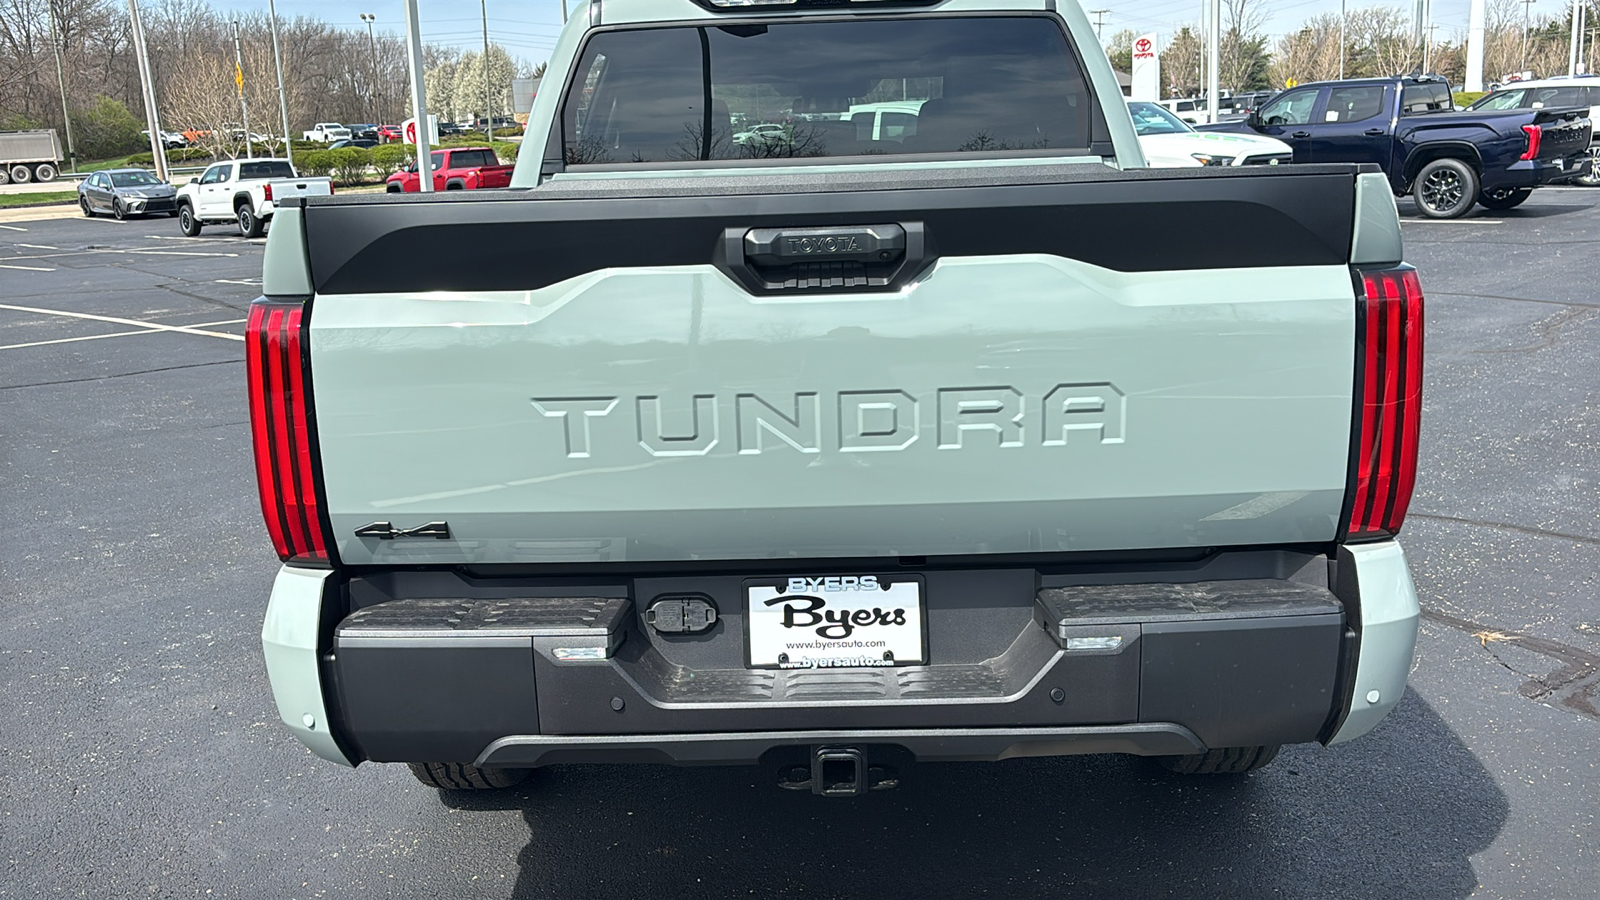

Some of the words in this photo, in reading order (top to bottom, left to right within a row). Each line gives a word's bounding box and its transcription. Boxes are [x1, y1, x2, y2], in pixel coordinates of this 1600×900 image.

[789, 237, 862, 254] TOYOTA
[531, 382, 1127, 459] TUNDRA
[788, 576, 878, 592] BYERS
[763, 595, 906, 639] Byers
[786, 640, 886, 650] www.byersauto.com
[779, 656, 894, 670] www.byersauto.com
